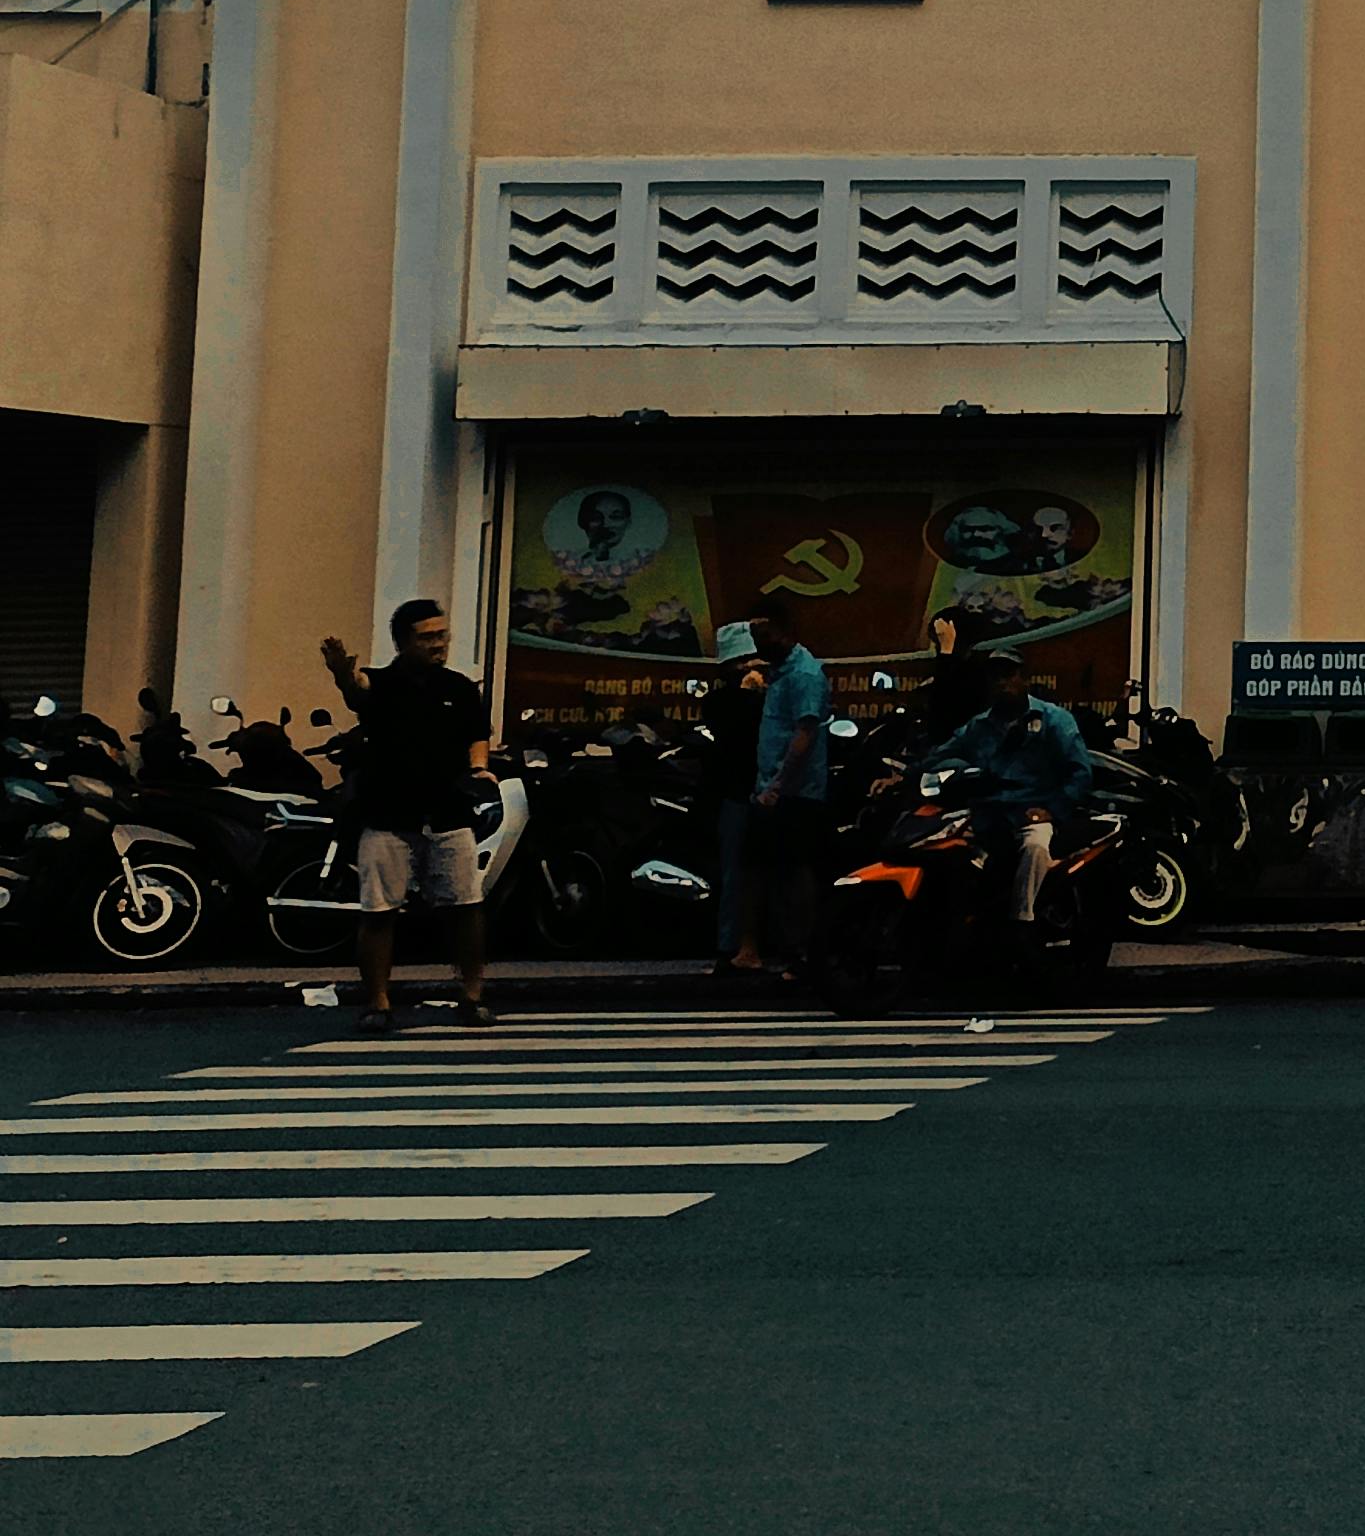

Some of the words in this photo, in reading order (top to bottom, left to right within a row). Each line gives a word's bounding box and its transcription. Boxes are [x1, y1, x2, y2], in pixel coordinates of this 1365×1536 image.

[1250, 649, 1274, 670] BỎ
[1280, 650, 1316, 670] RÁC
[1246, 677, 1282, 697] GÓP
